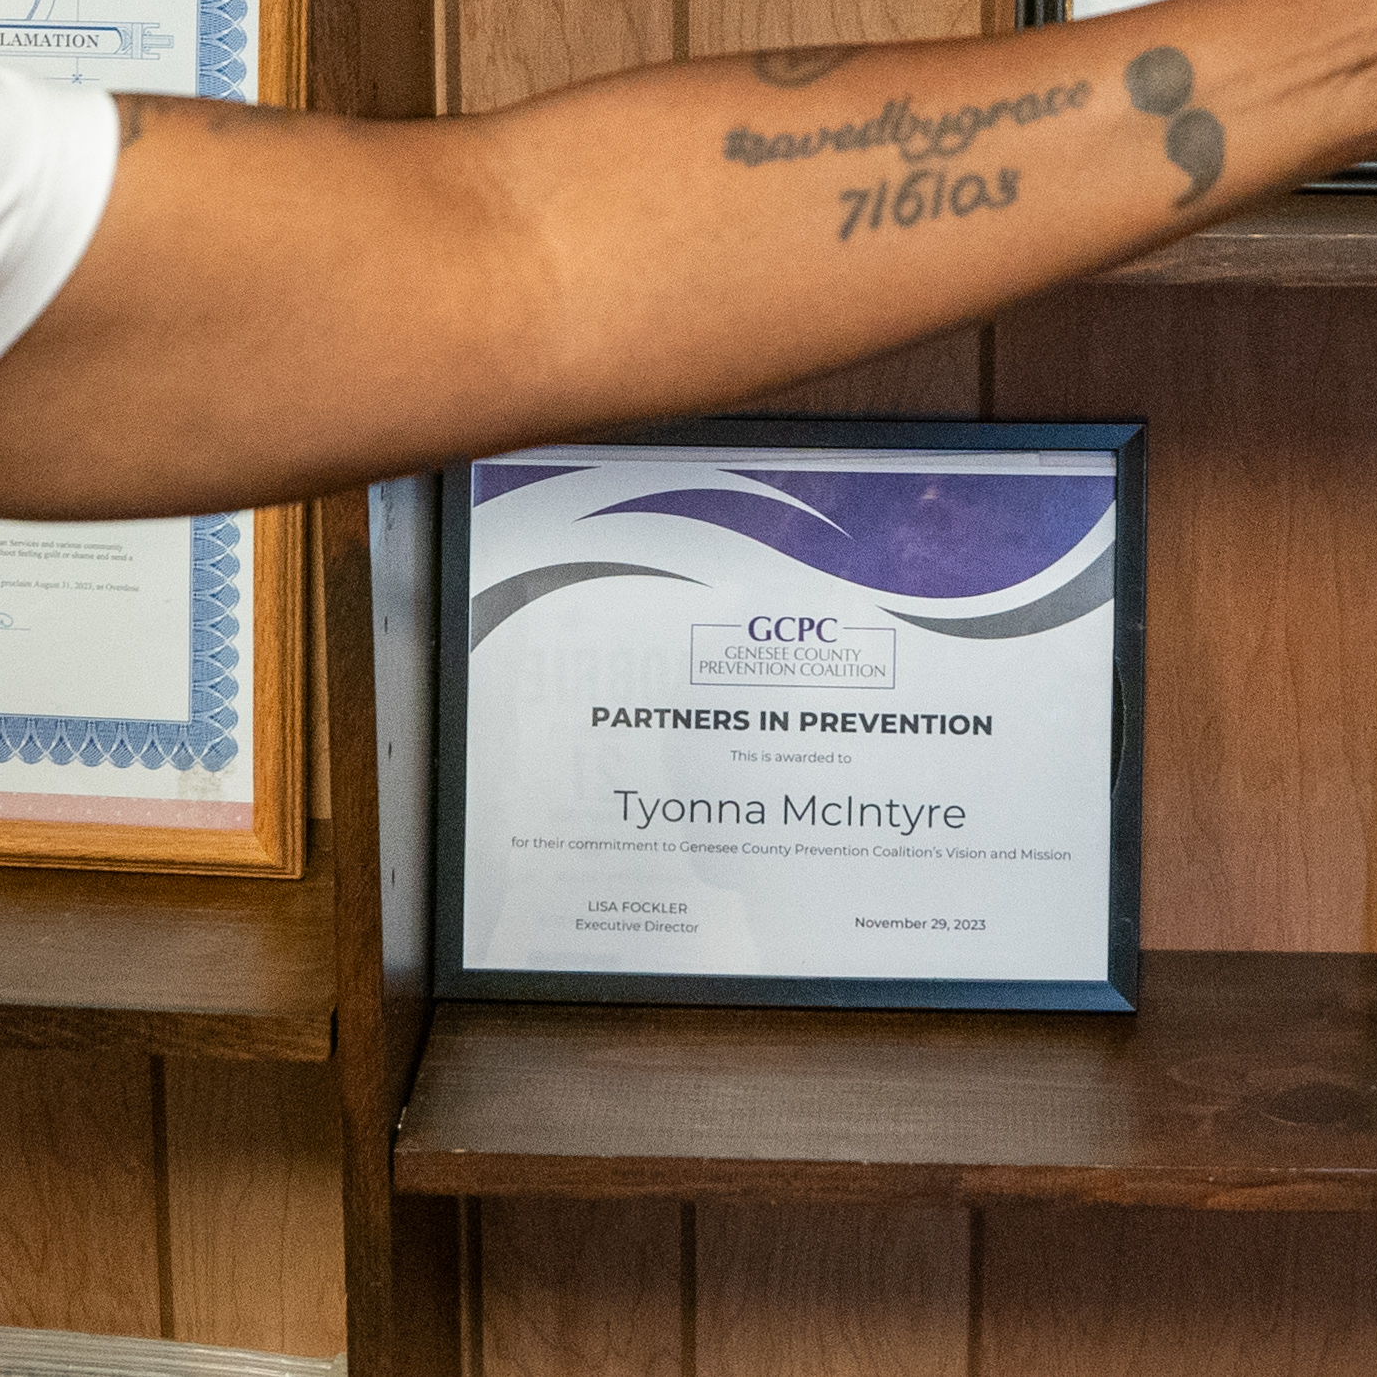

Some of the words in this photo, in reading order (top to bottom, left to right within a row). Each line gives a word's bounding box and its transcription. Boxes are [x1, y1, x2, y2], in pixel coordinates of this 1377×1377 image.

[747, 615, 838, 644] GCPC
[724, 646, 792, 662] GENESEE
[794, 647, 862, 663] COUNTY
[698, 660, 797, 677] PREVENTION
[799, 662, 887, 679] COALITION
[591, 706, 750, 732] PARTNERS
[759, 709, 789, 733] IN
[800, 710, 993, 737] PREVENTION
[730, 749, 757, 763] This
[760, 749, 772, 763] is
[773, 750, 834, 764] awarded
[837, 751, 852, 764] to
[613, 790, 766, 831] Tyonna
[783, 794, 967, 837] McIntyre
[511, 836, 529, 849] for
[533, 837, 564, 849] their
[568, 839, 658, 851] commitment
[663, 841, 676, 852] to
[680, 841, 738, 854] Genesee
[742, 843, 791, 857] County
[794, 843, 869, 857] Prevention
[946, 847, 987, 859] Vision
[990, 848, 1016, 860] and
[1021, 849, 1072, 861] Mission
[588, 900, 618, 912] LISA
[622, 901, 688, 915] FOCKLER
[575, 919, 641, 932] Executive
[645, 921, 699, 933] Director
[855, 917, 926, 929] November
[931, 918, 950, 931] 29,
[954, 919, 986, 931] 2023
